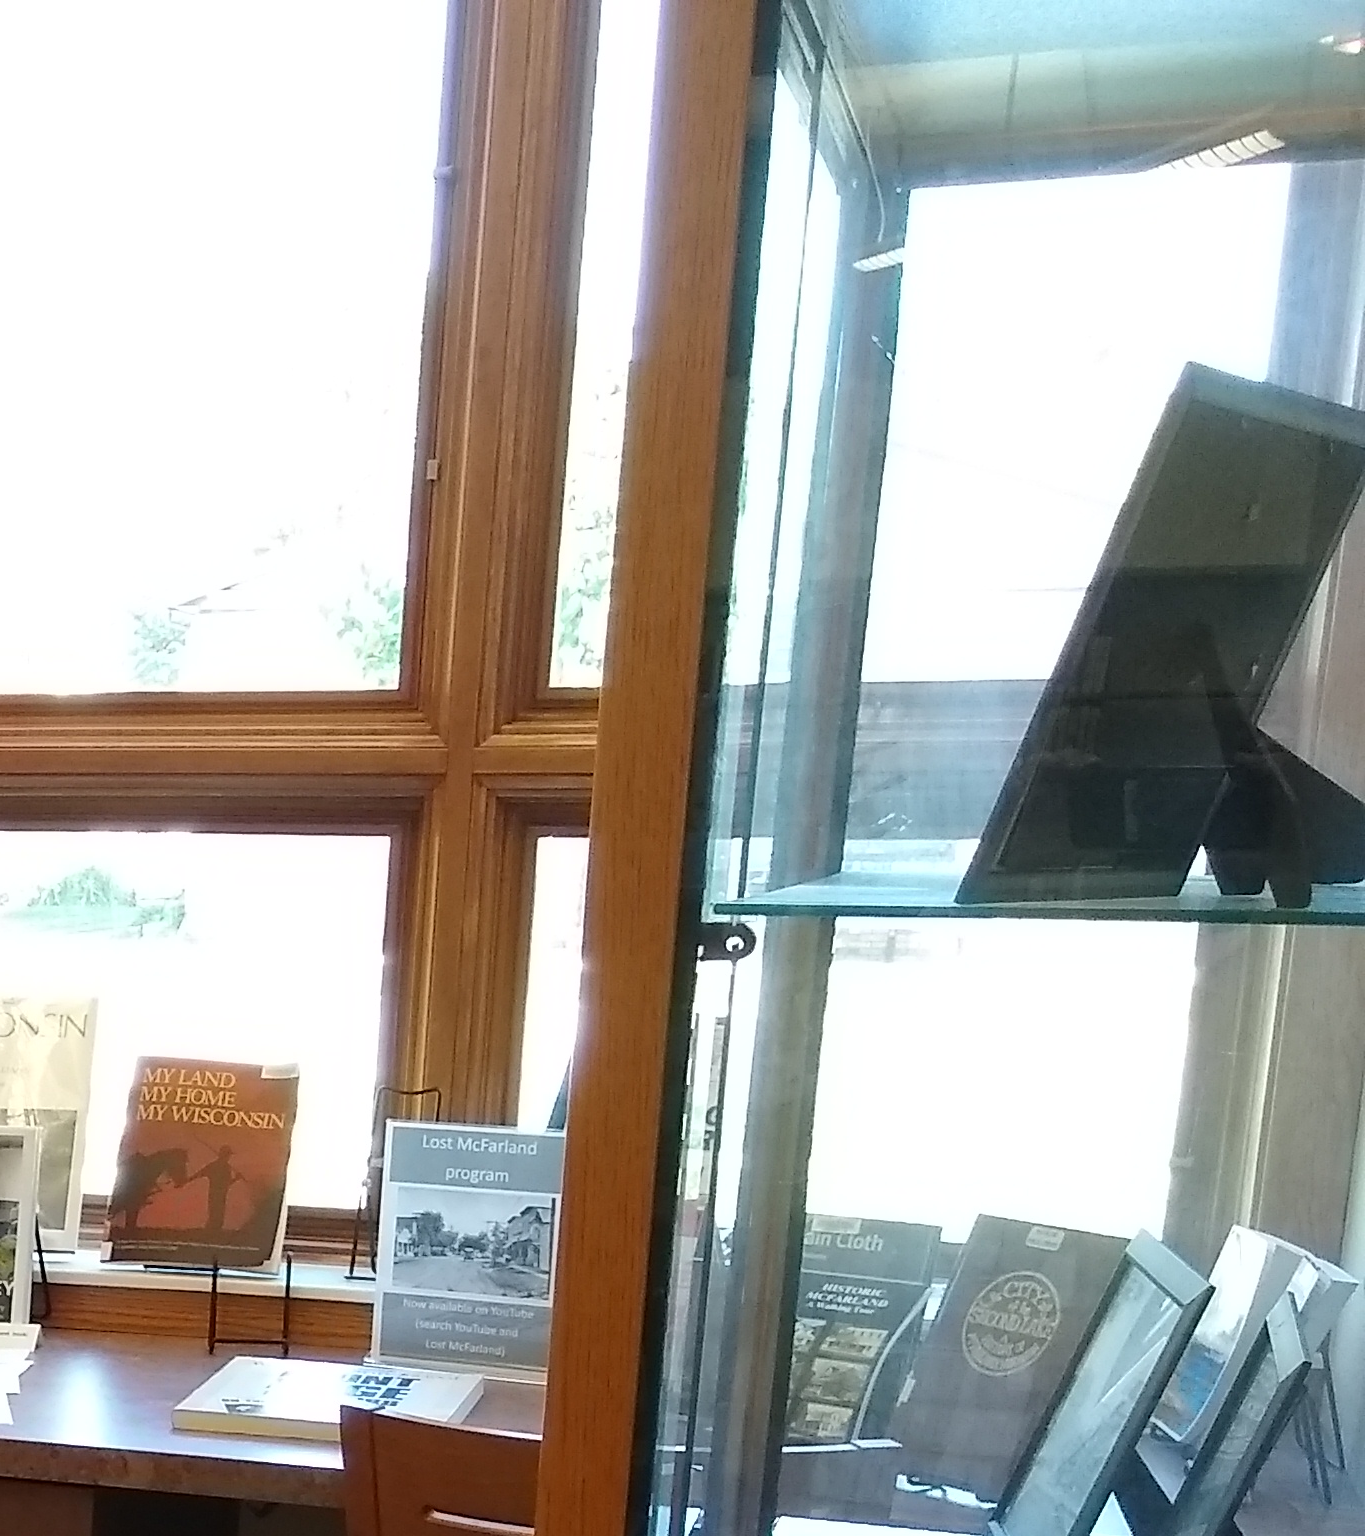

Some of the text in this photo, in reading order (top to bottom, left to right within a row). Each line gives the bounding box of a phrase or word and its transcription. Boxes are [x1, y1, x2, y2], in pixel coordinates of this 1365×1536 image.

[143, 1068, 236, 1088] MY LAND
[139, 1086, 237, 1107] MY HOME
[137, 1104, 287, 1129] MY WISCONSIN
[422, 1134, 538, 1156] Lost McFarland
[445, 1167, 510, 1184] program
[835, 1234, 884, 1251] Cloth
[805, 1290, 889, 1309] MCFARLAND
[822, 1282, 887, 1298] HISTORIC
[1003, 1280, 1050, 1301] CITY
[403, 1298, 535, 1320] Now available on YouTube
[816, 1302, 876, 1316] Walking Tour
[414, 1318, 519, 1338] (search YouTube and
[425, 1339, 507, 1358] Lost McFarland)
